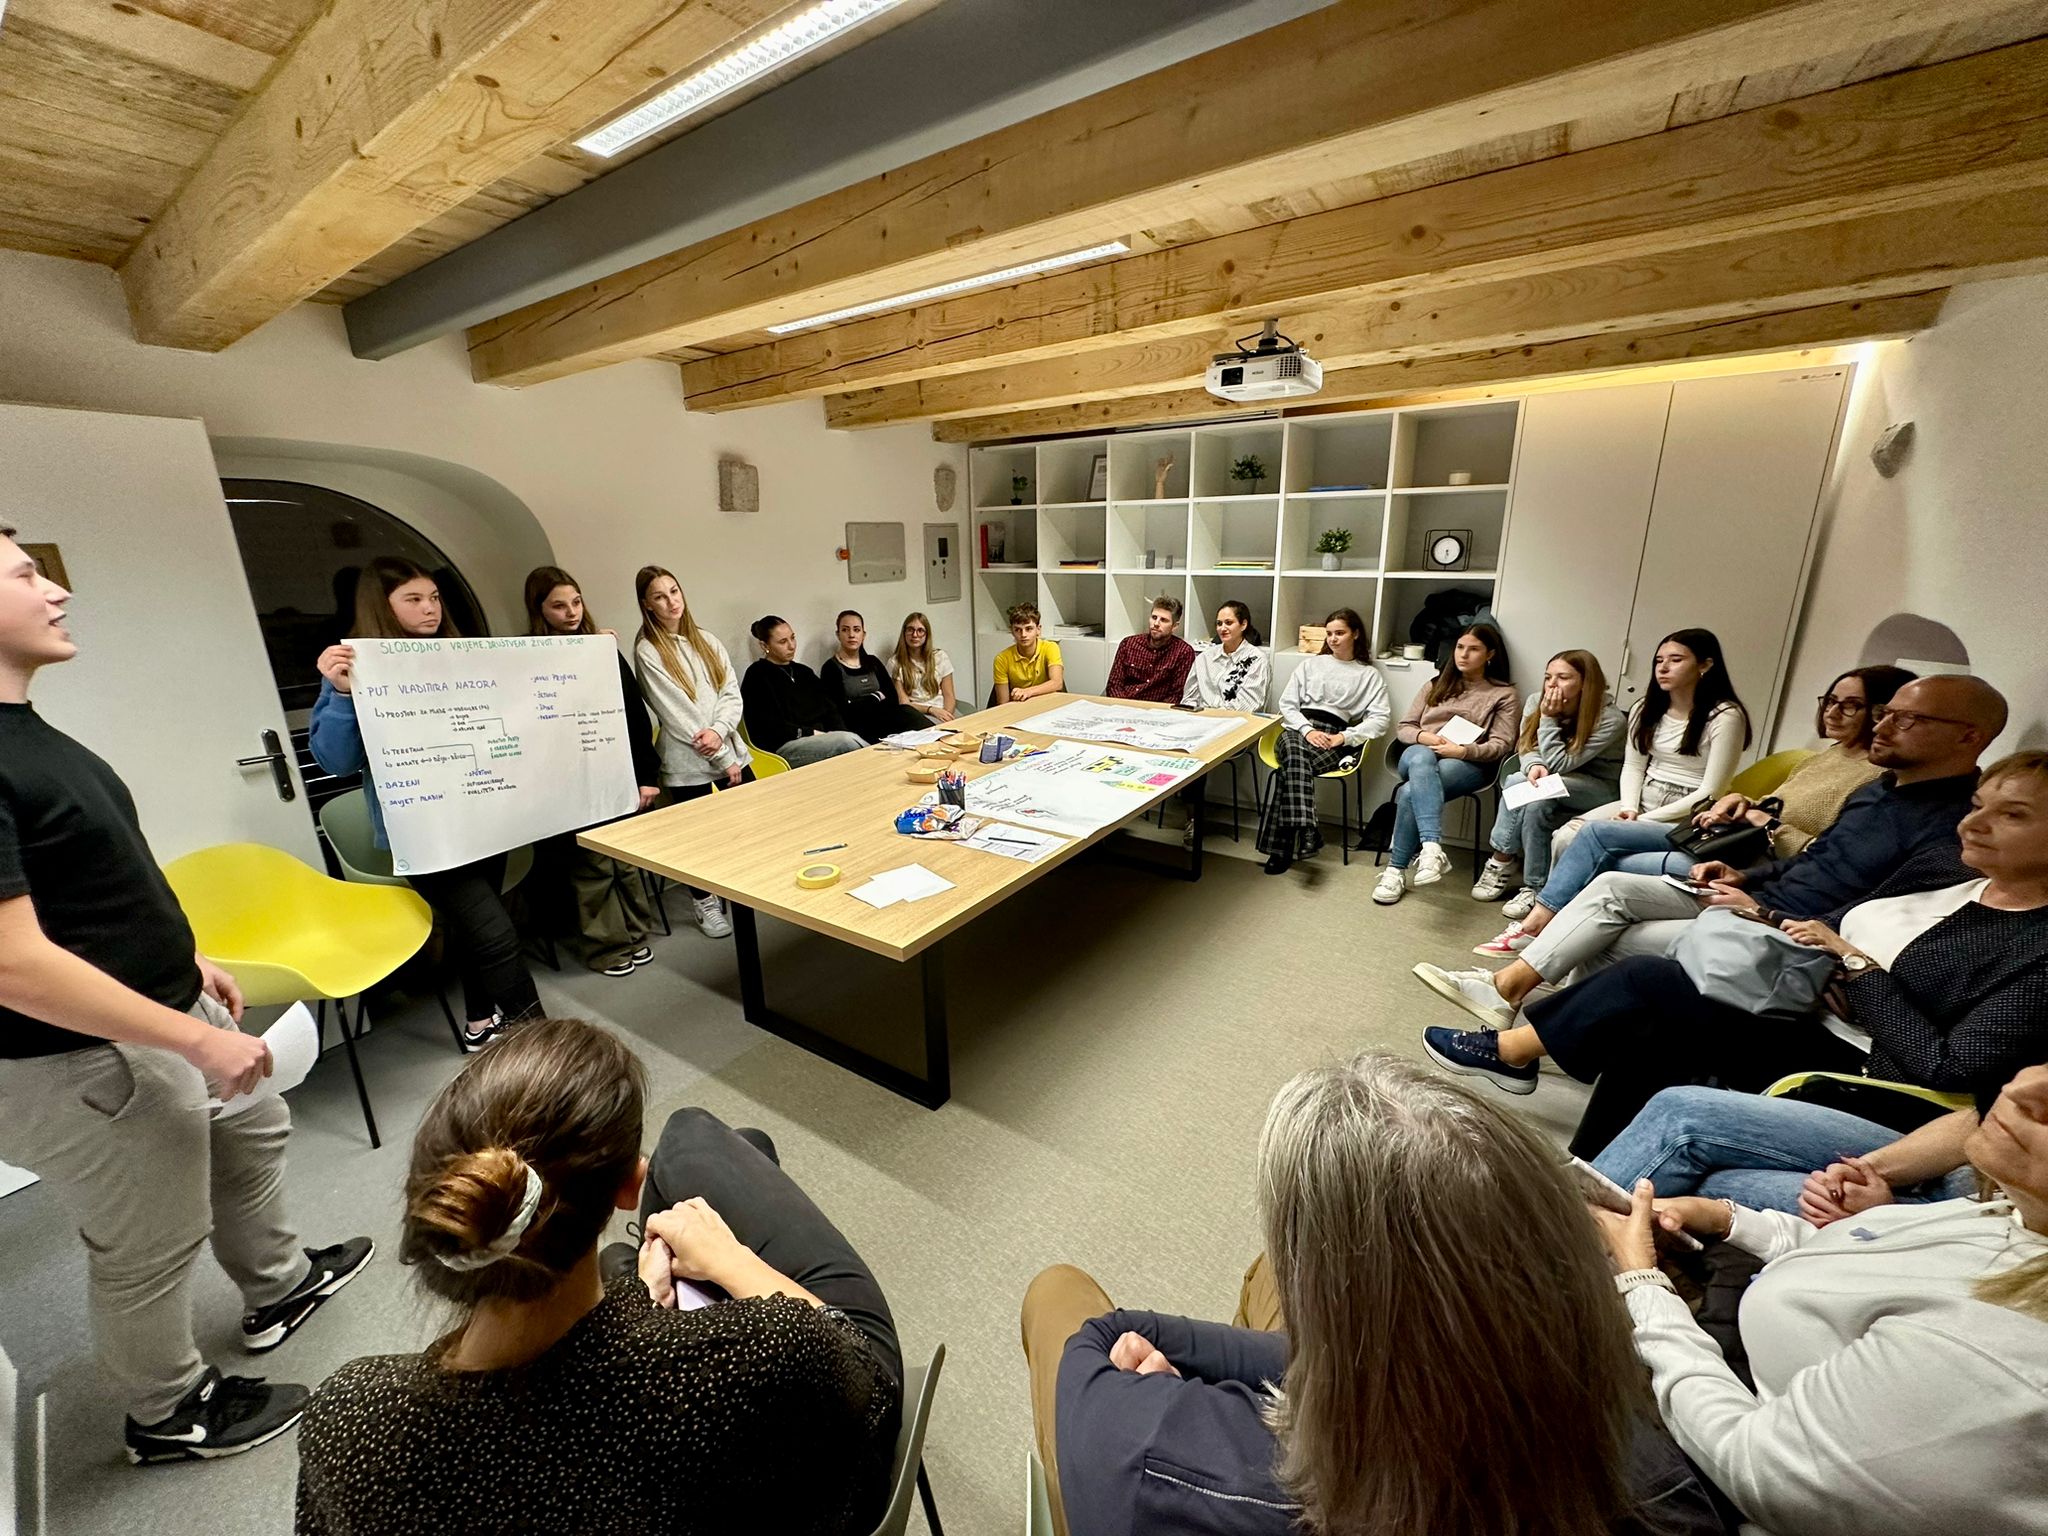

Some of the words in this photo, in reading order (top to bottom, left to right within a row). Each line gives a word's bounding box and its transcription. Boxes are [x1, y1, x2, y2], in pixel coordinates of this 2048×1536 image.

[380, 641, 441, 655] SLOBODNO
[566, 637, 585, 646] SPORT
[367, 685, 389, 698] PUT
[398, 682, 449, 695] VLADIMIRA
[455, 680, 498, 690] NAZORA
[386, 710, 417, 719] PROSTORI
[385, 779, 420, 789] BAZENI
[389, 797, 415, 808] SAVJET
